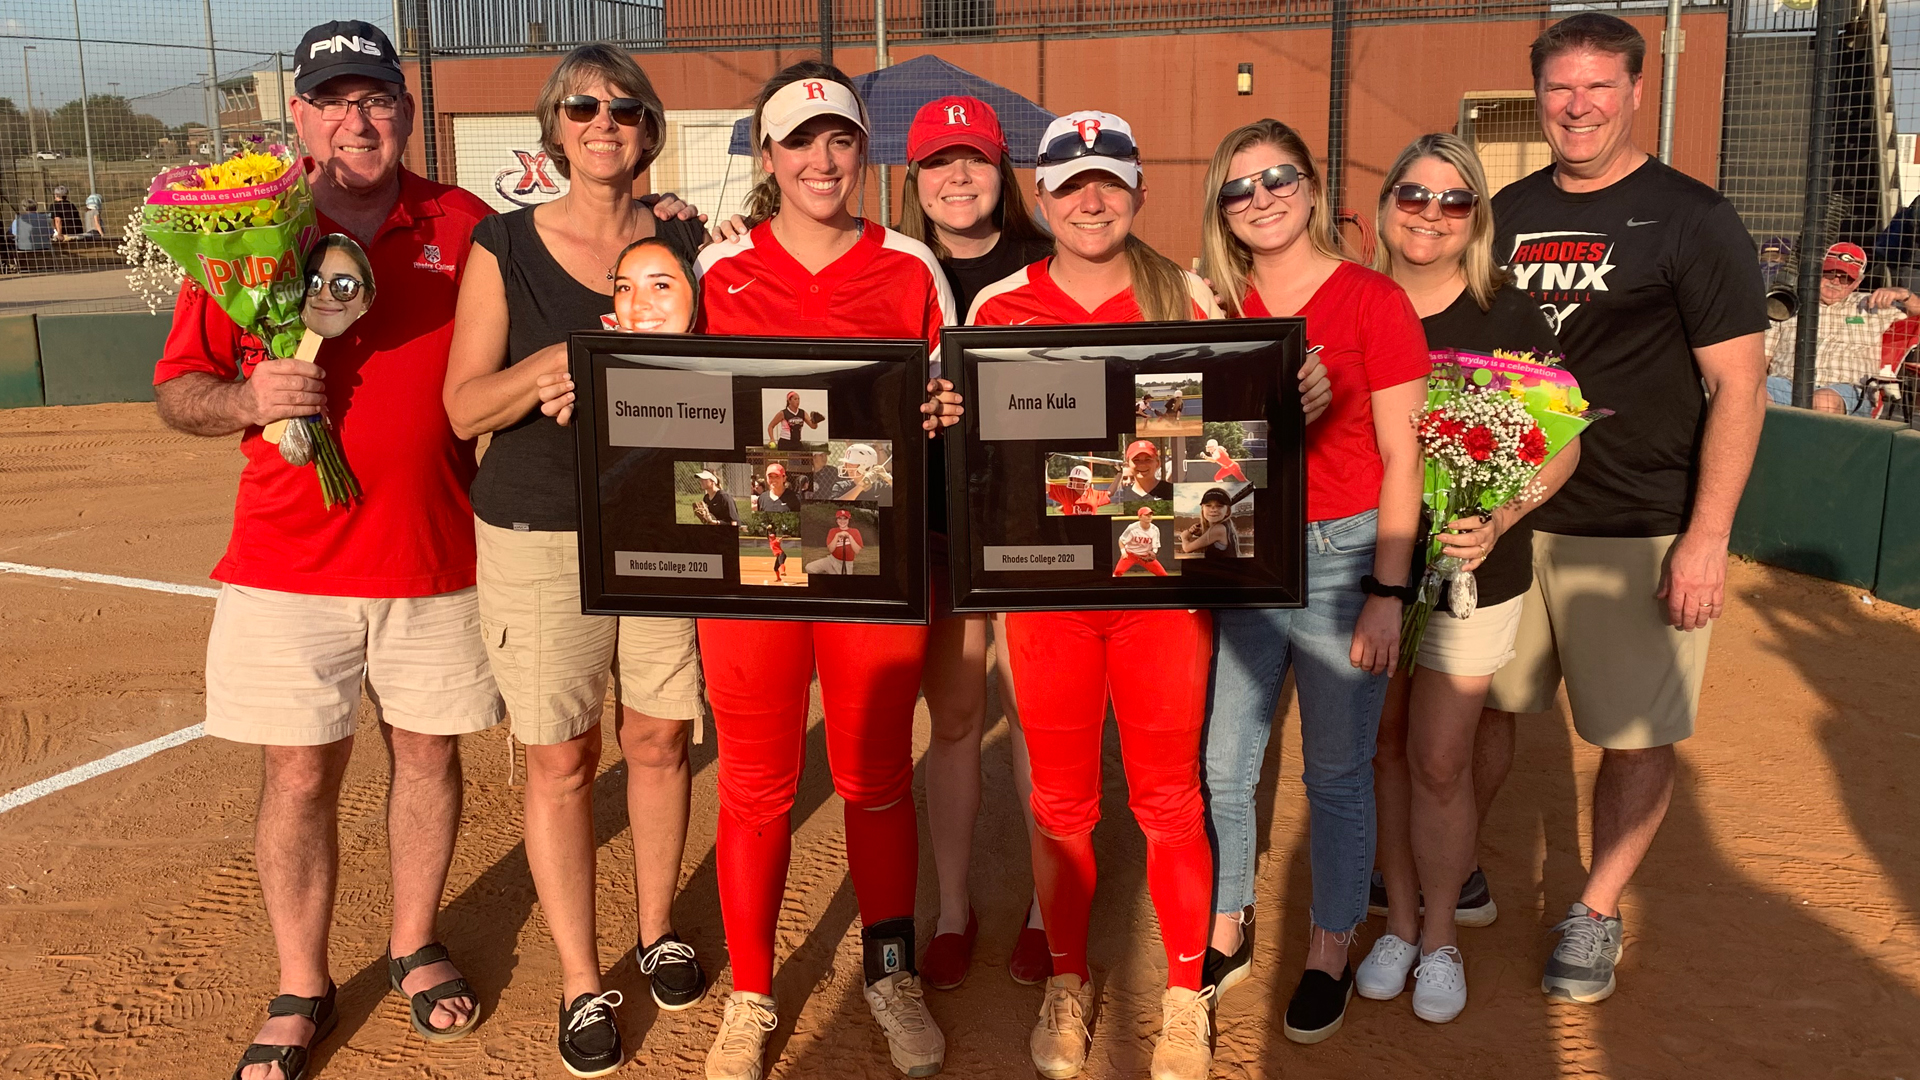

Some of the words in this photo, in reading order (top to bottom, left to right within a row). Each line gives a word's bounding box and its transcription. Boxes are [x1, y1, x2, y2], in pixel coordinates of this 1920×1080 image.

[310, 34, 381, 59] PING
[803, 81, 828, 101] R
[944, 105, 971, 126] R
[1072, 119, 1101, 142] R
[172, 193, 198, 201] Cada
[232, 190, 252, 198] una
[253, 184, 278, 196] fiesta
[1514, 241, 1606, 263] RHODES
[1500, 262, 1617, 291] YNX
[1507, 362, 1557, 379] celebration
[1008, 394, 1042, 410] Anna
[1047, 393, 1076, 410] Kula
[616, 401, 673, 419] Shannon
[677, 403, 727, 424] Tierney
[630, 560, 657, 571] Rhodes
[659, 561, 686, 574] College
[689, 562, 708, 572] 2020
[1002, 555, 1029, 563] Rhodes
[1030, 554, 1056, 565] College
[1058, 554, 1075, 563] 2020
